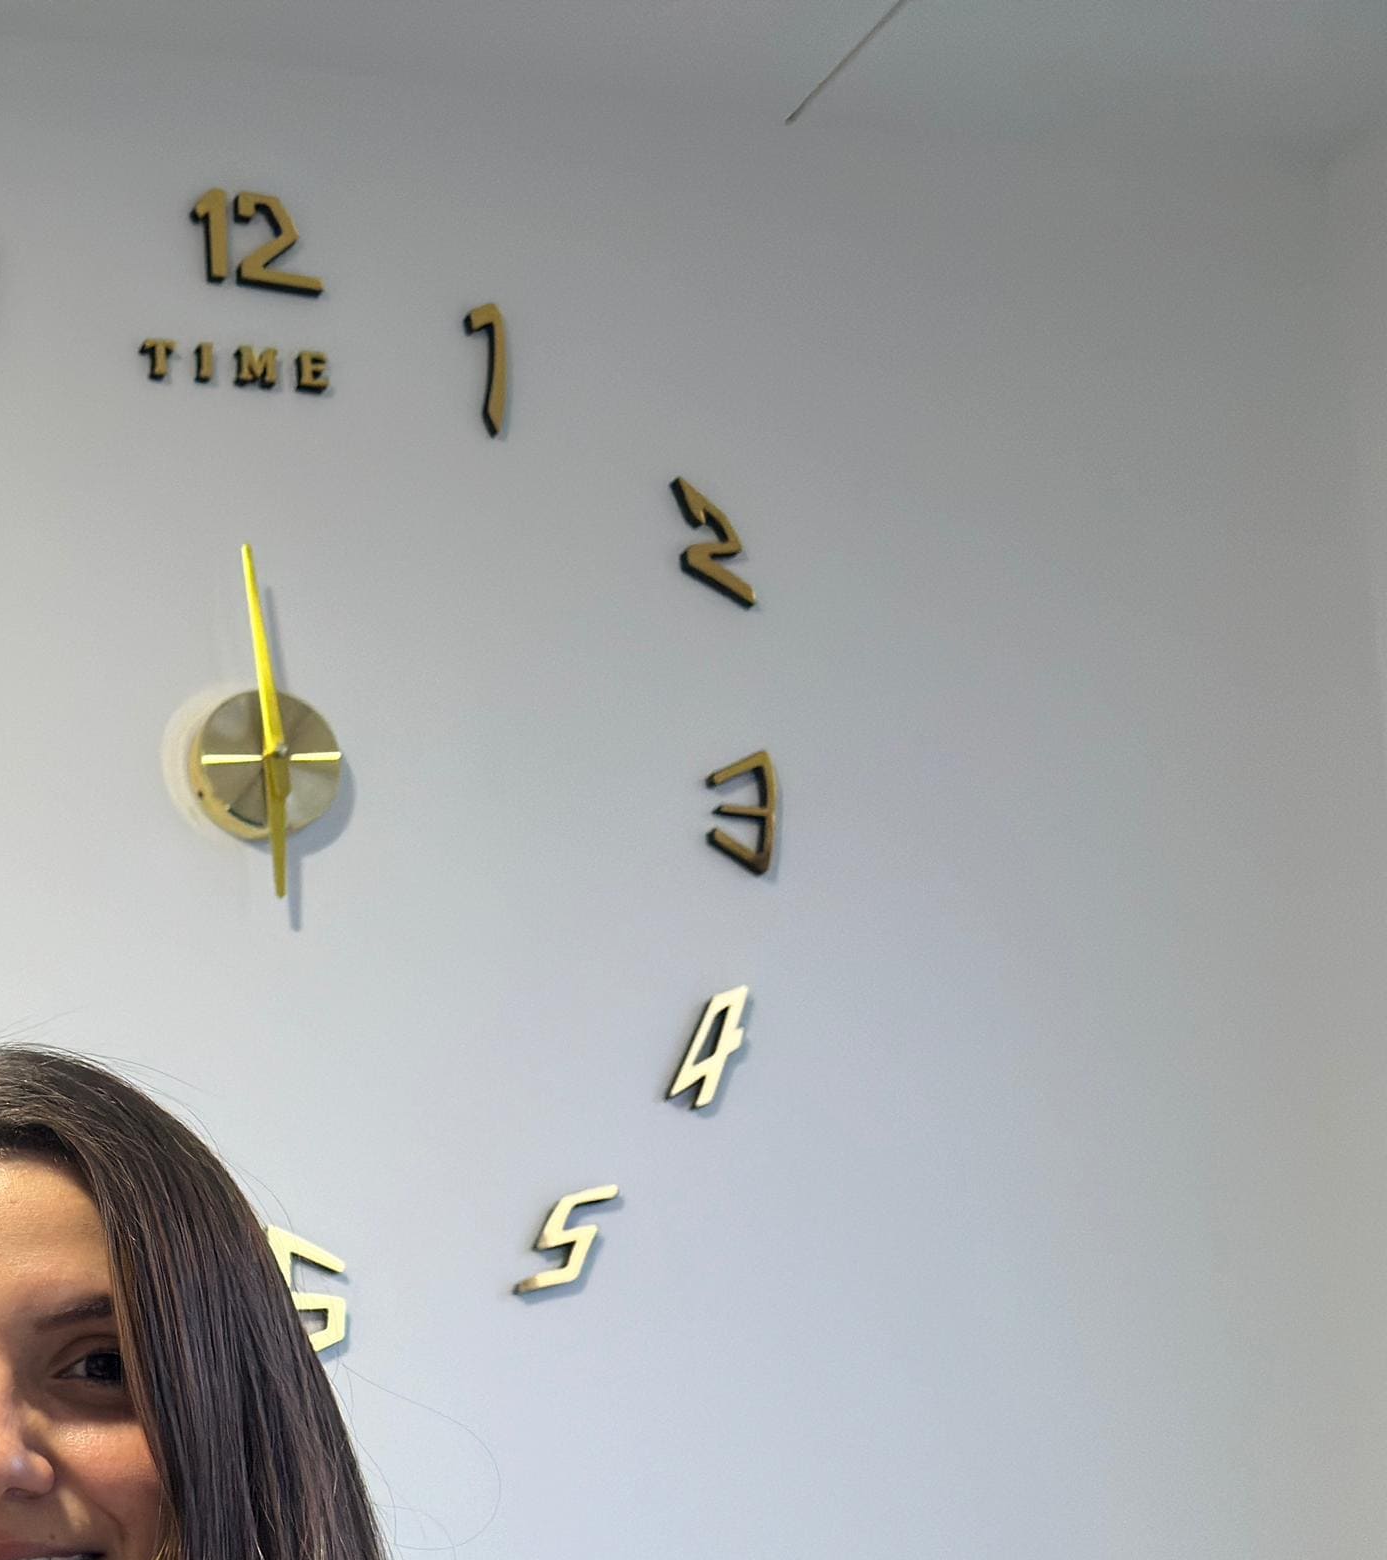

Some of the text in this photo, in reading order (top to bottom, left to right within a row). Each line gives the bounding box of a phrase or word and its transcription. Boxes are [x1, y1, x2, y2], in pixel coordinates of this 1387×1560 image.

[190, 187, 324, 298] 12
[139, 339, 331, 394] TIME
[464, 303, 506, 437] 1
[670, 477, 757, 610] 2
[706, 750, 777, 875] 3
[664, 985, 749, 1111] 4
[513, 1184, 620, 1295] 5
